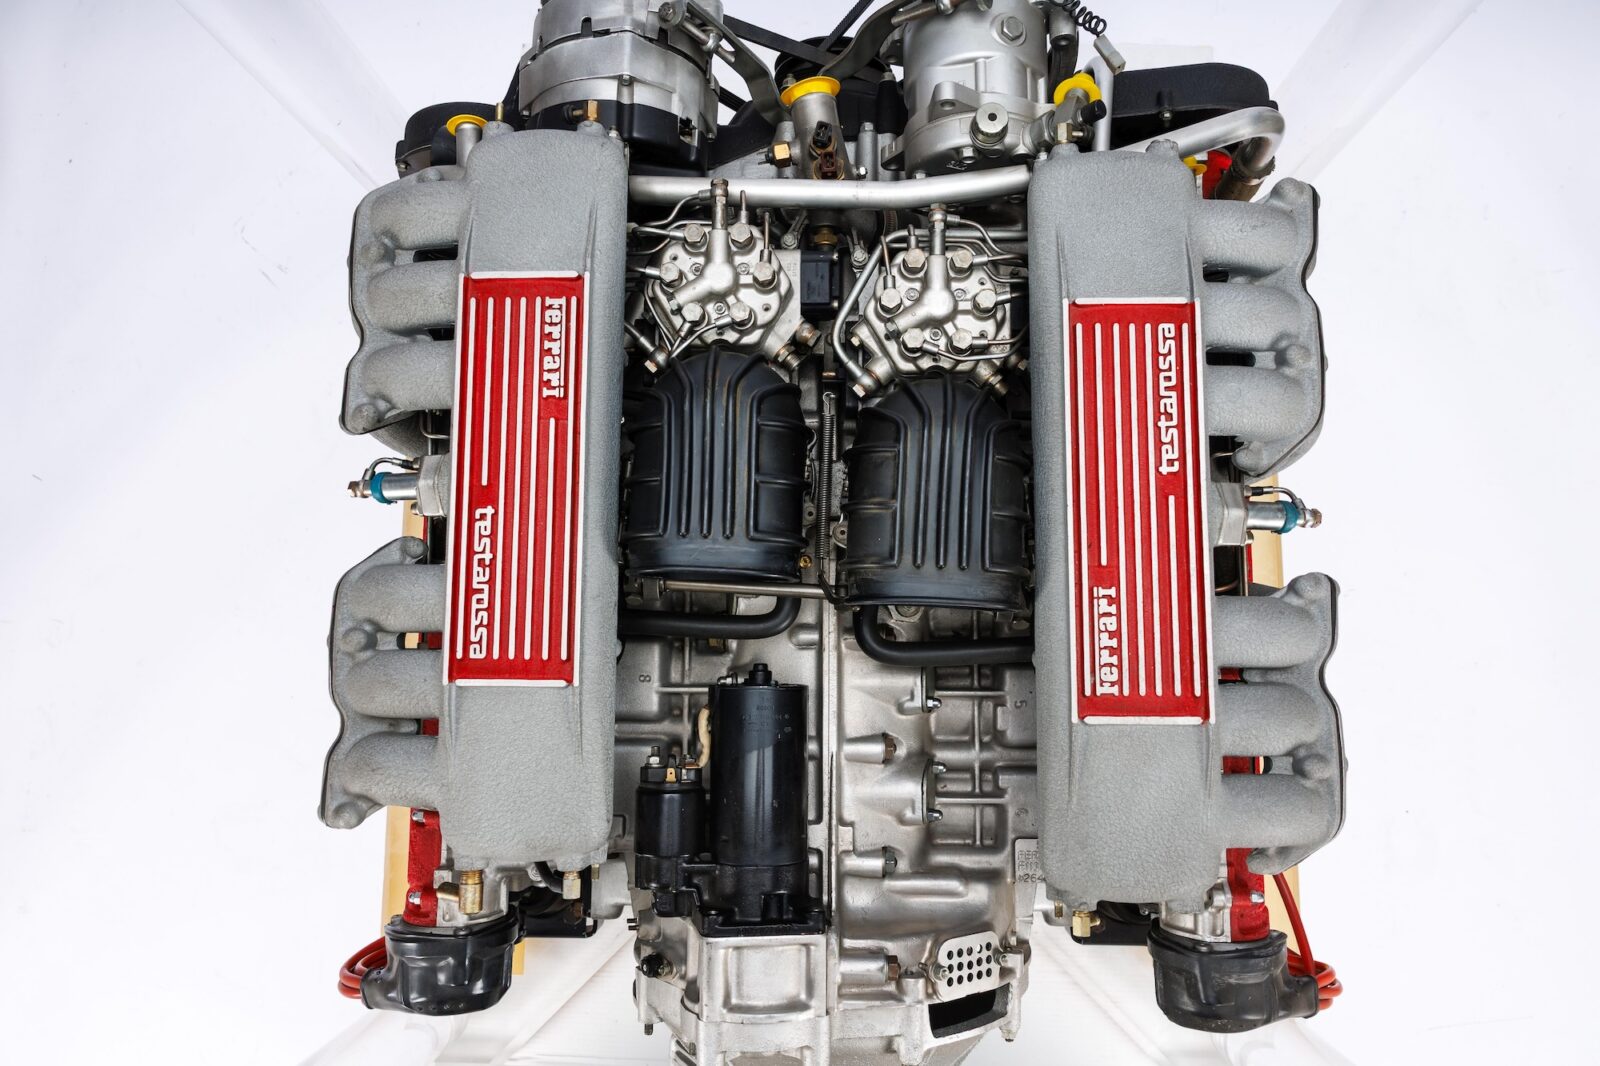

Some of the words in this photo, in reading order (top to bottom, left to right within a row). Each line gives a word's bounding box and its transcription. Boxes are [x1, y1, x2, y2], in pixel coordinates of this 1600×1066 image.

[542, 296, 565, 398] Ferrari
[1158, 323, 1179, 475] testarossa
[469, 505, 495, 659] testarossa
[638, 674, 652, 683] 8
[1093, 586, 1119, 696] Ferrari
